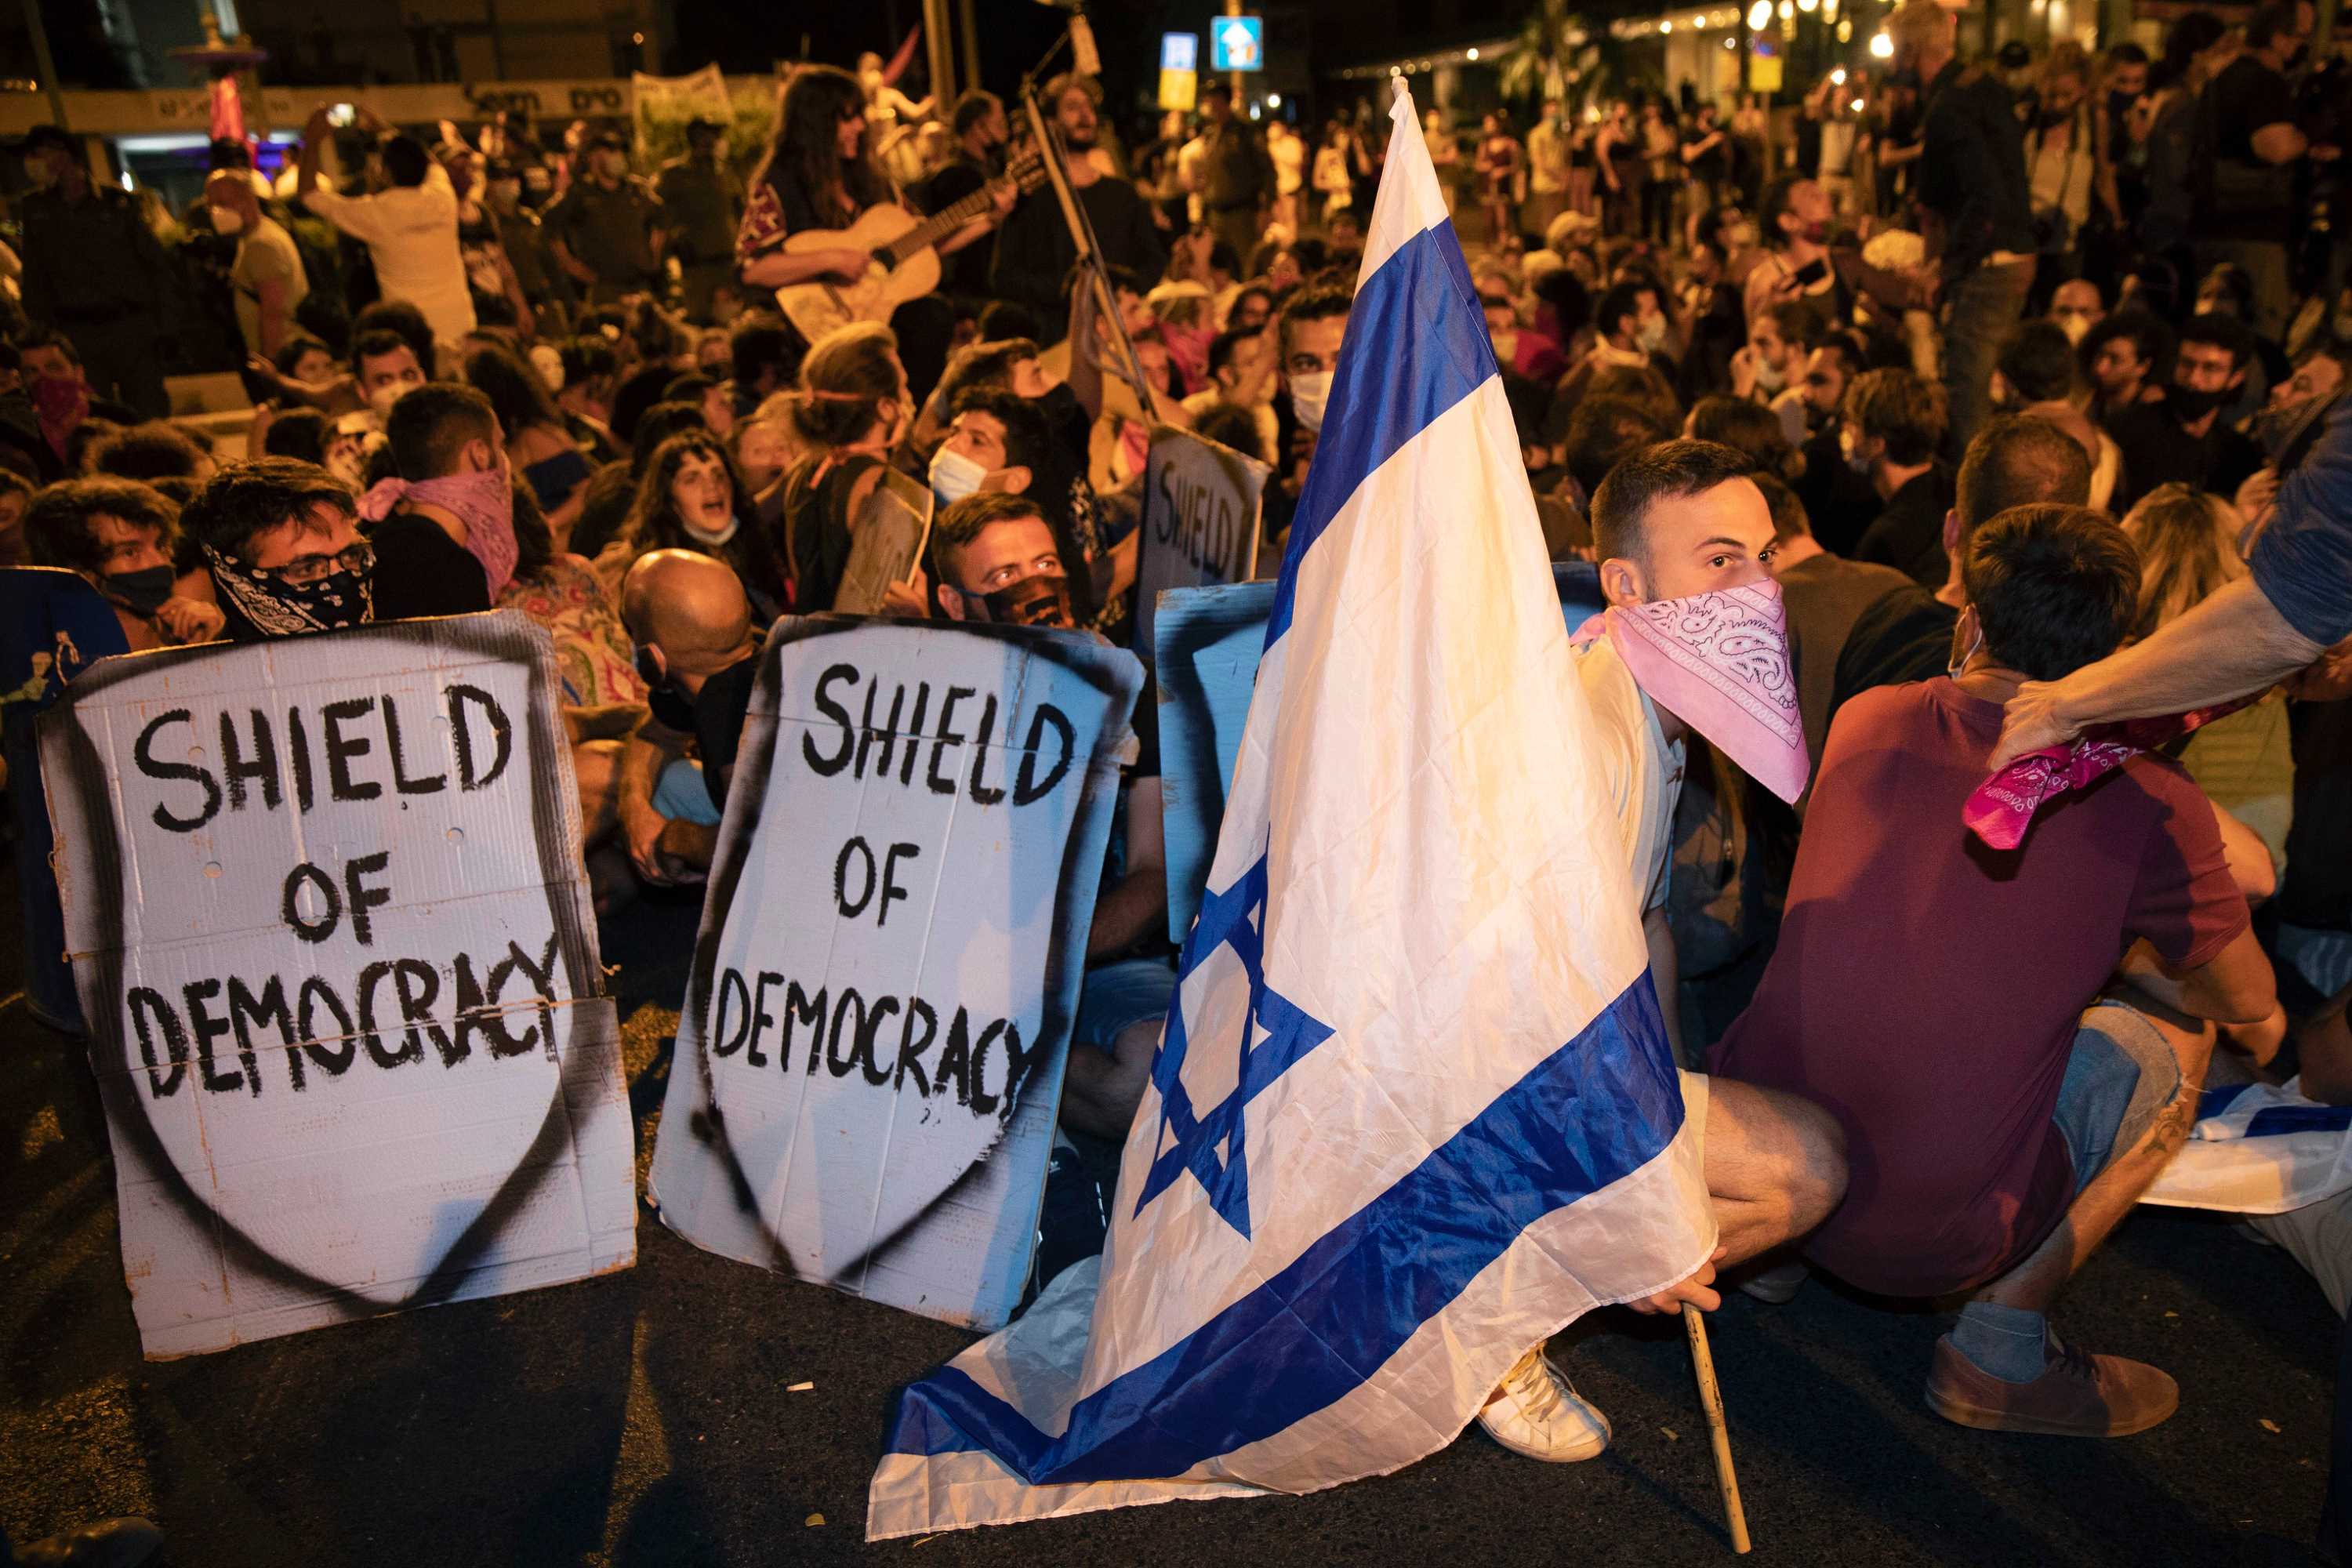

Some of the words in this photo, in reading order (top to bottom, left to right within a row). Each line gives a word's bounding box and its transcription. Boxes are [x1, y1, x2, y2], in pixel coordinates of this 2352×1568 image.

[1155, 461, 1232, 579] SHIELD
[135, 684, 511, 833] SHIELD
[803, 663, 1076, 806] SHIELD
[282, 852, 390, 946] OF
[833, 836, 920, 926] OF
[127, 931, 559, 1098] DEMOCRACY
